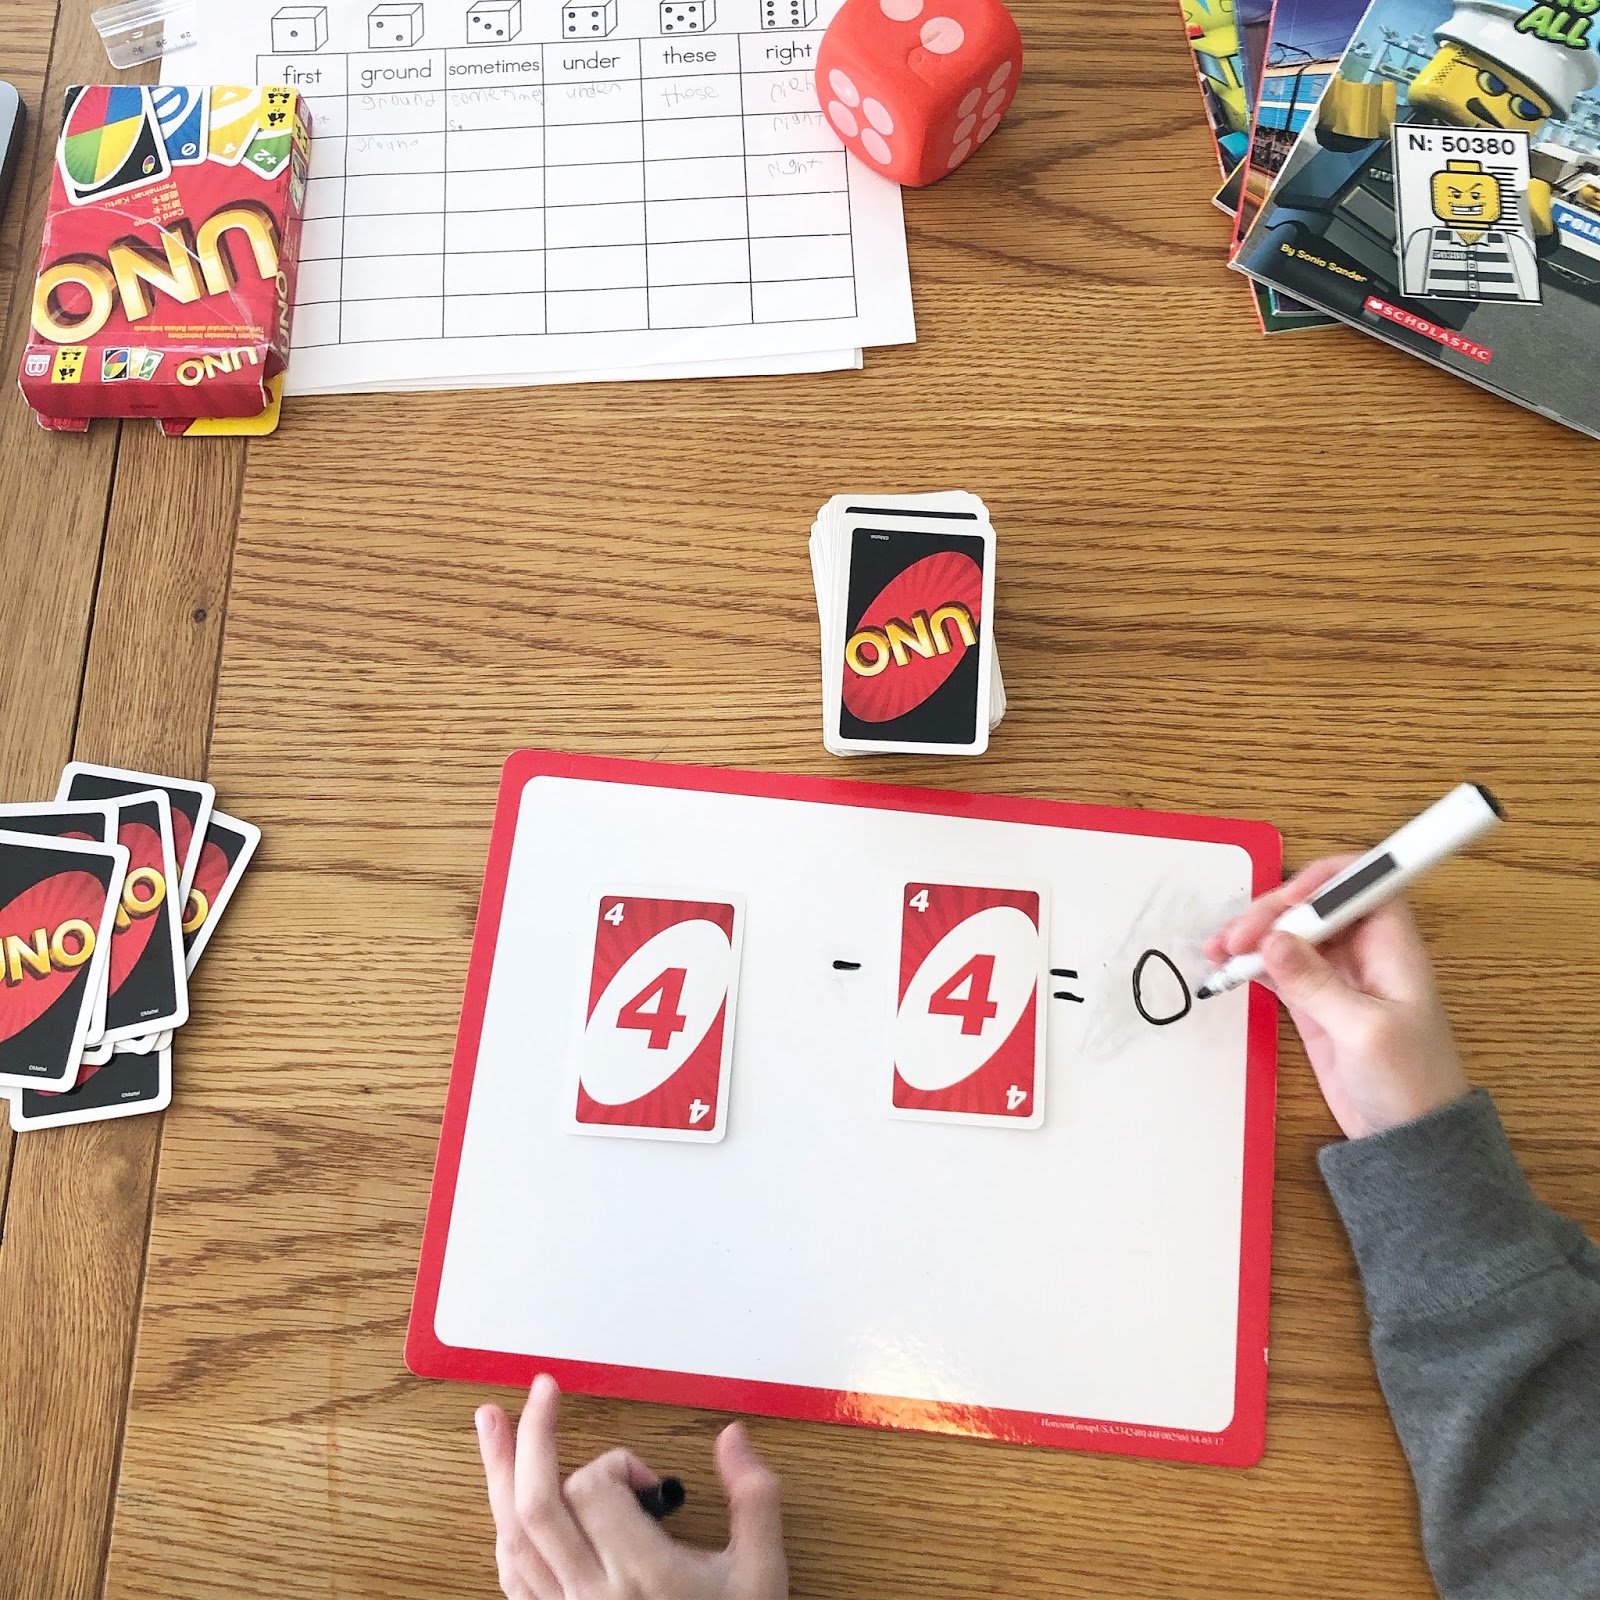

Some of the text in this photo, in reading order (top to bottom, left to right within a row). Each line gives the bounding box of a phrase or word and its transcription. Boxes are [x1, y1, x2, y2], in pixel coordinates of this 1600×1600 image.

[1516, 5, 1590, 47] ALL
[563, 50, 621, 71] under
[662, 46, 717, 65] these
[766, 41, 812, 65] right
[282, 65, 322, 85] first
[361, 59, 432, 88] ground
[449, 60, 540, 76] sometimes
[361, 92, 437, 111] ground
[1409, 134, 1515, 155] N: 50380
[104, 181, 177, 208] Permainan Kartu
[163, 208, 185, 220] Card
[1557, 212, 1600, 239] POLI
[31, 203, 279, 343] UNO
[1280, 243, 1368, 283] By Sonia Sander
[275, 270, 290, 356] UNO
[1383, 304, 1491, 361] SCHOLASTIC
[176, 346, 259, 387] UNO
[845, 603, 978, 677] UNO
[909, 889, 930, 912] 4
[604, 903, 625, 926] 4
[0, 918, 97, 983] NO
[927, 953, 998, 1037] 4
[1132, 949, 1192, 1026] 0
[616, 966, 688, 1051] 4
[1005, 1084, 1027, 1110] 4
[689, 1098, 711, 1124] 4
